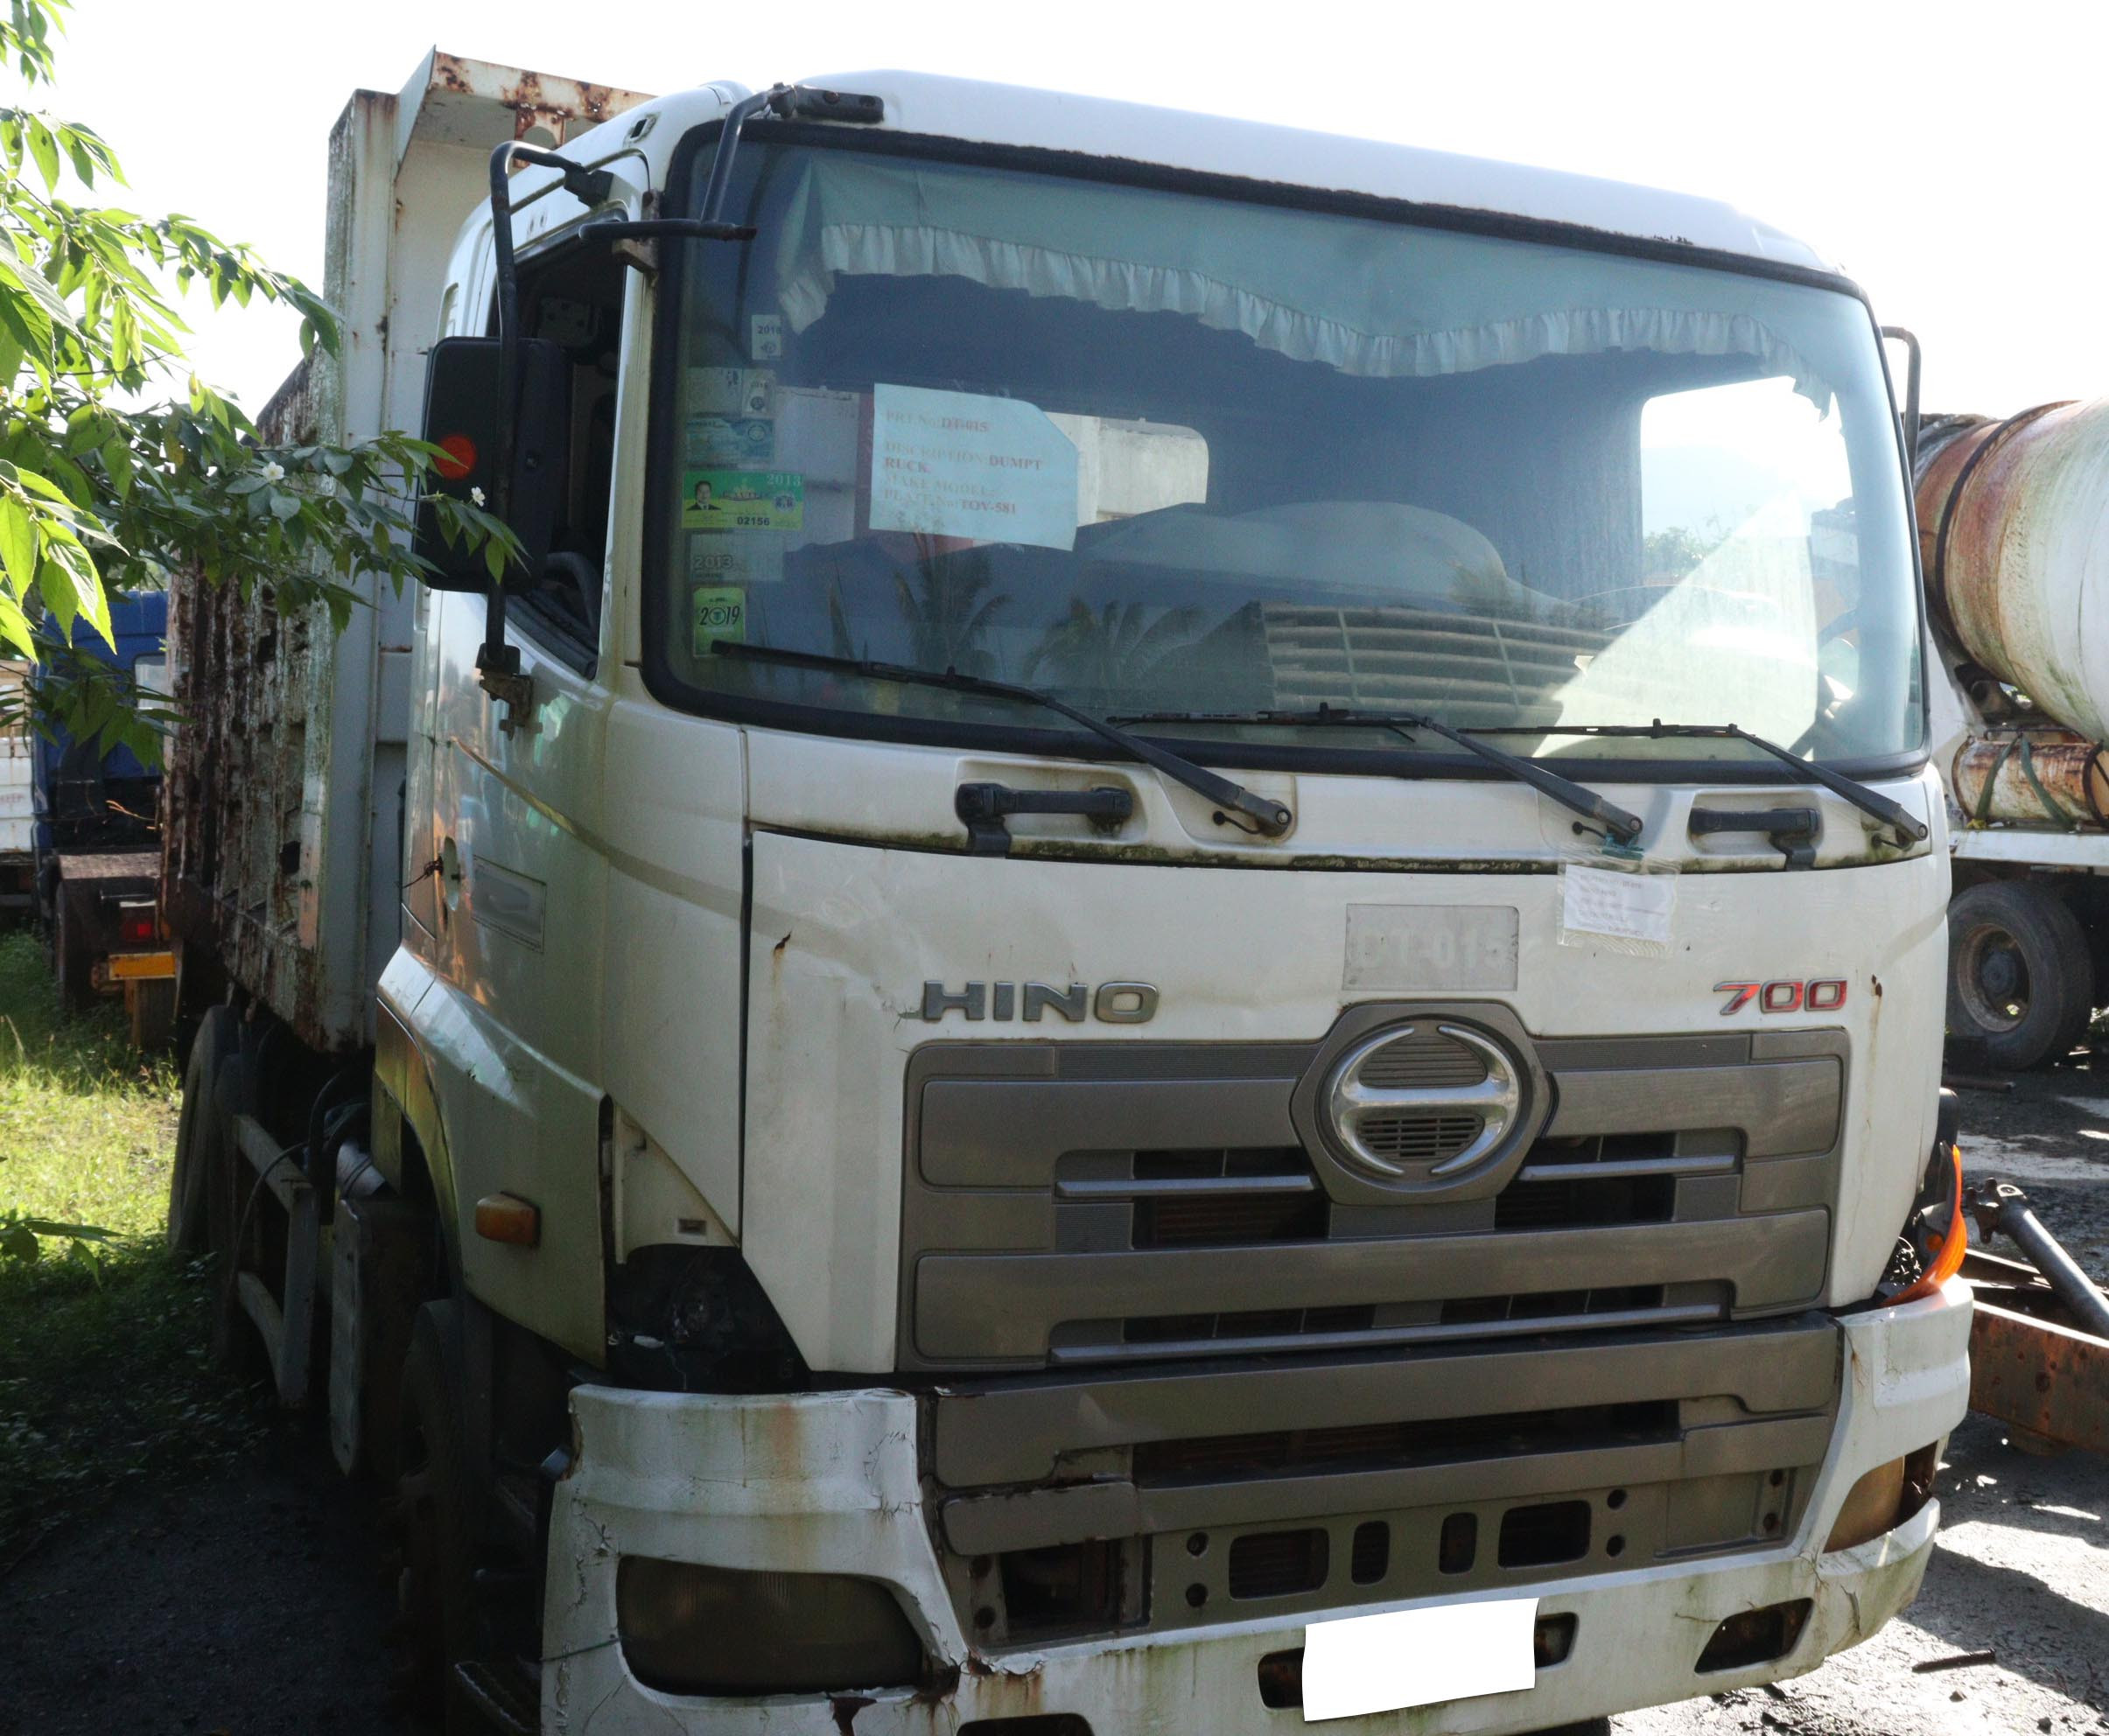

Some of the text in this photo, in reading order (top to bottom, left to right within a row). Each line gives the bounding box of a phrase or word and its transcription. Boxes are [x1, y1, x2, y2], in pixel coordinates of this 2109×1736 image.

[767, 473, 802, 487] 2013
[737, 516, 770, 526] 02156
[692, 554, 734, 570] 2013
[699, 606, 741, 626] 2019
[922, 980, 1160, 1024] HINO
[1713, 977, 1848, 1016] 700
